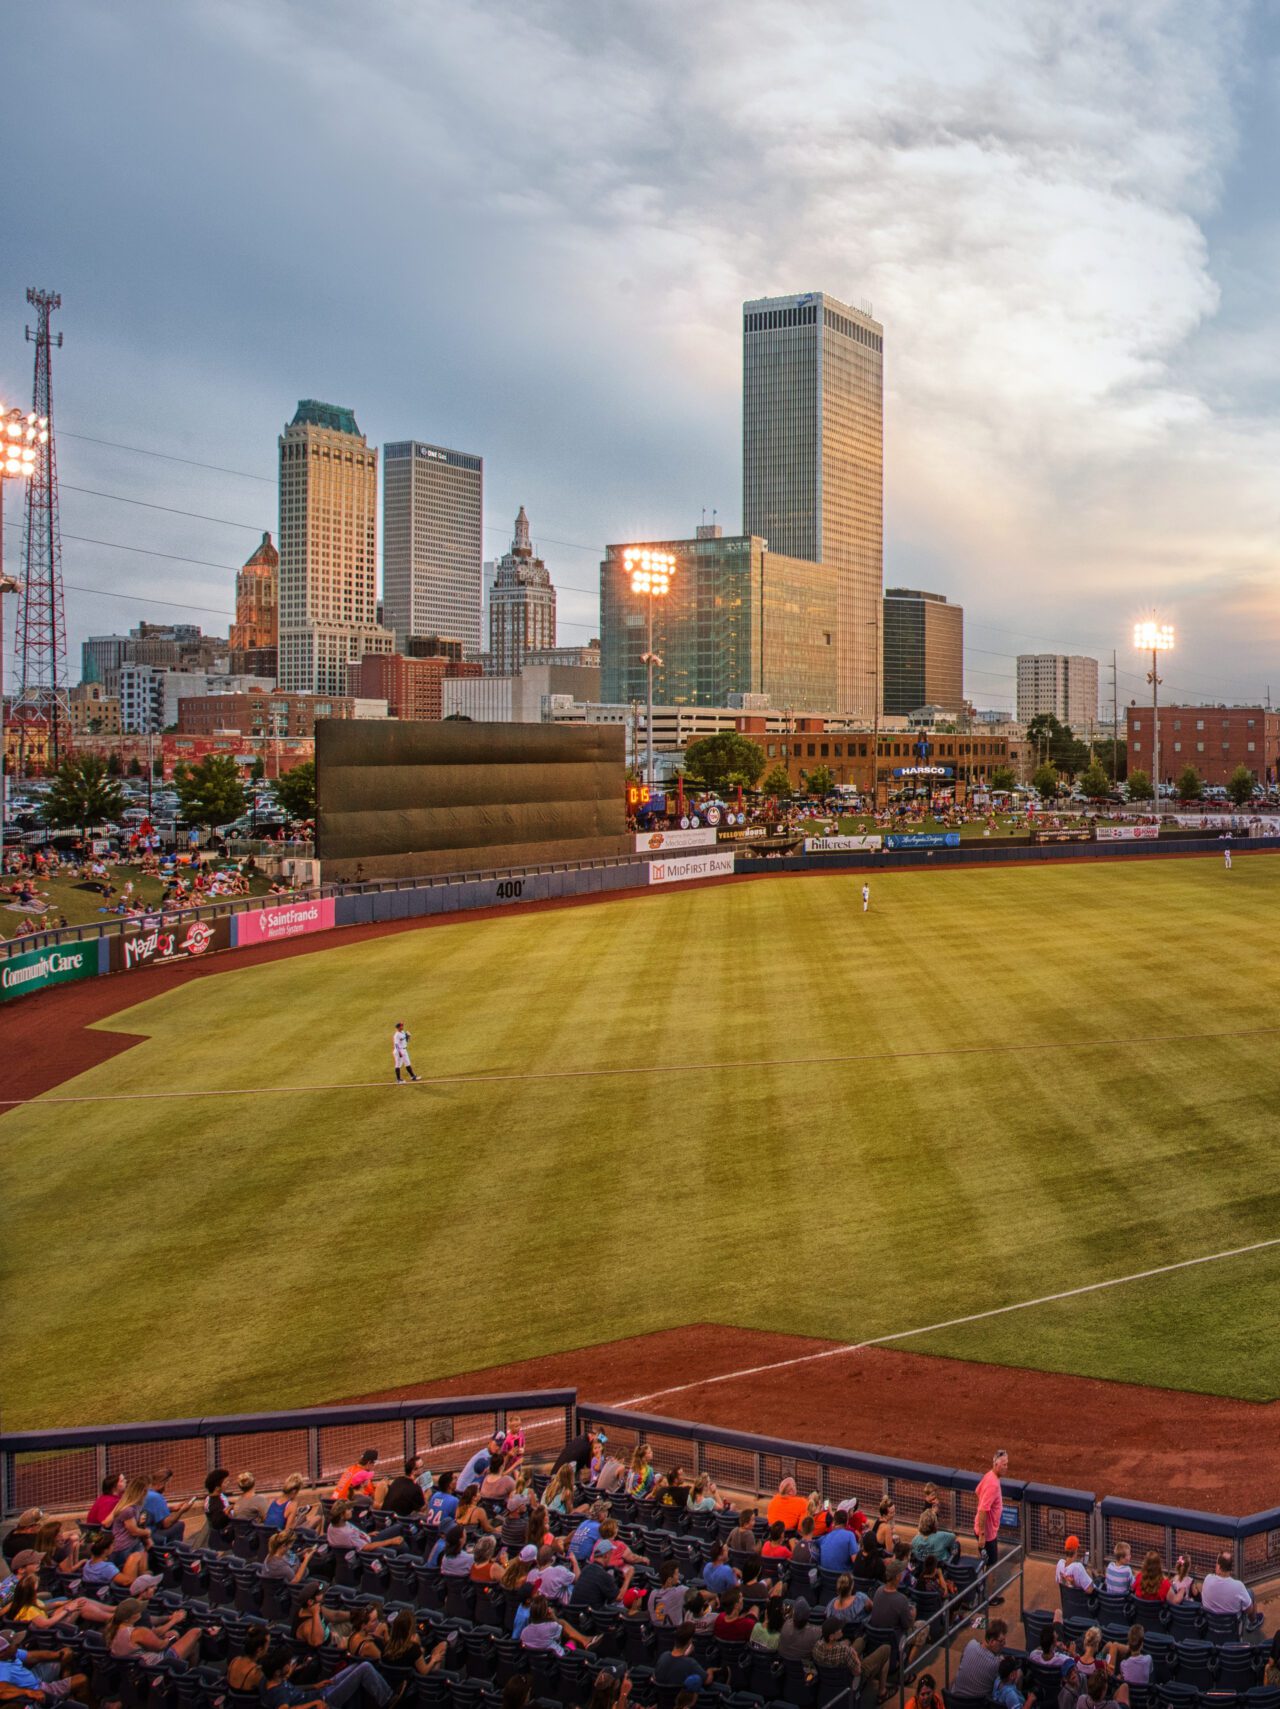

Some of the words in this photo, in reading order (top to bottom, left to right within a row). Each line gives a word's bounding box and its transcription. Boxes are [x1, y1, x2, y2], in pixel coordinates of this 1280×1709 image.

[901, 767, 945, 775] HARSCO
[630, 787, 649, 803] 0:15
[811, 839, 851, 849] hillcrest
[710, 860, 732, 870] BANK
[269, 926, 285, 937] Health
